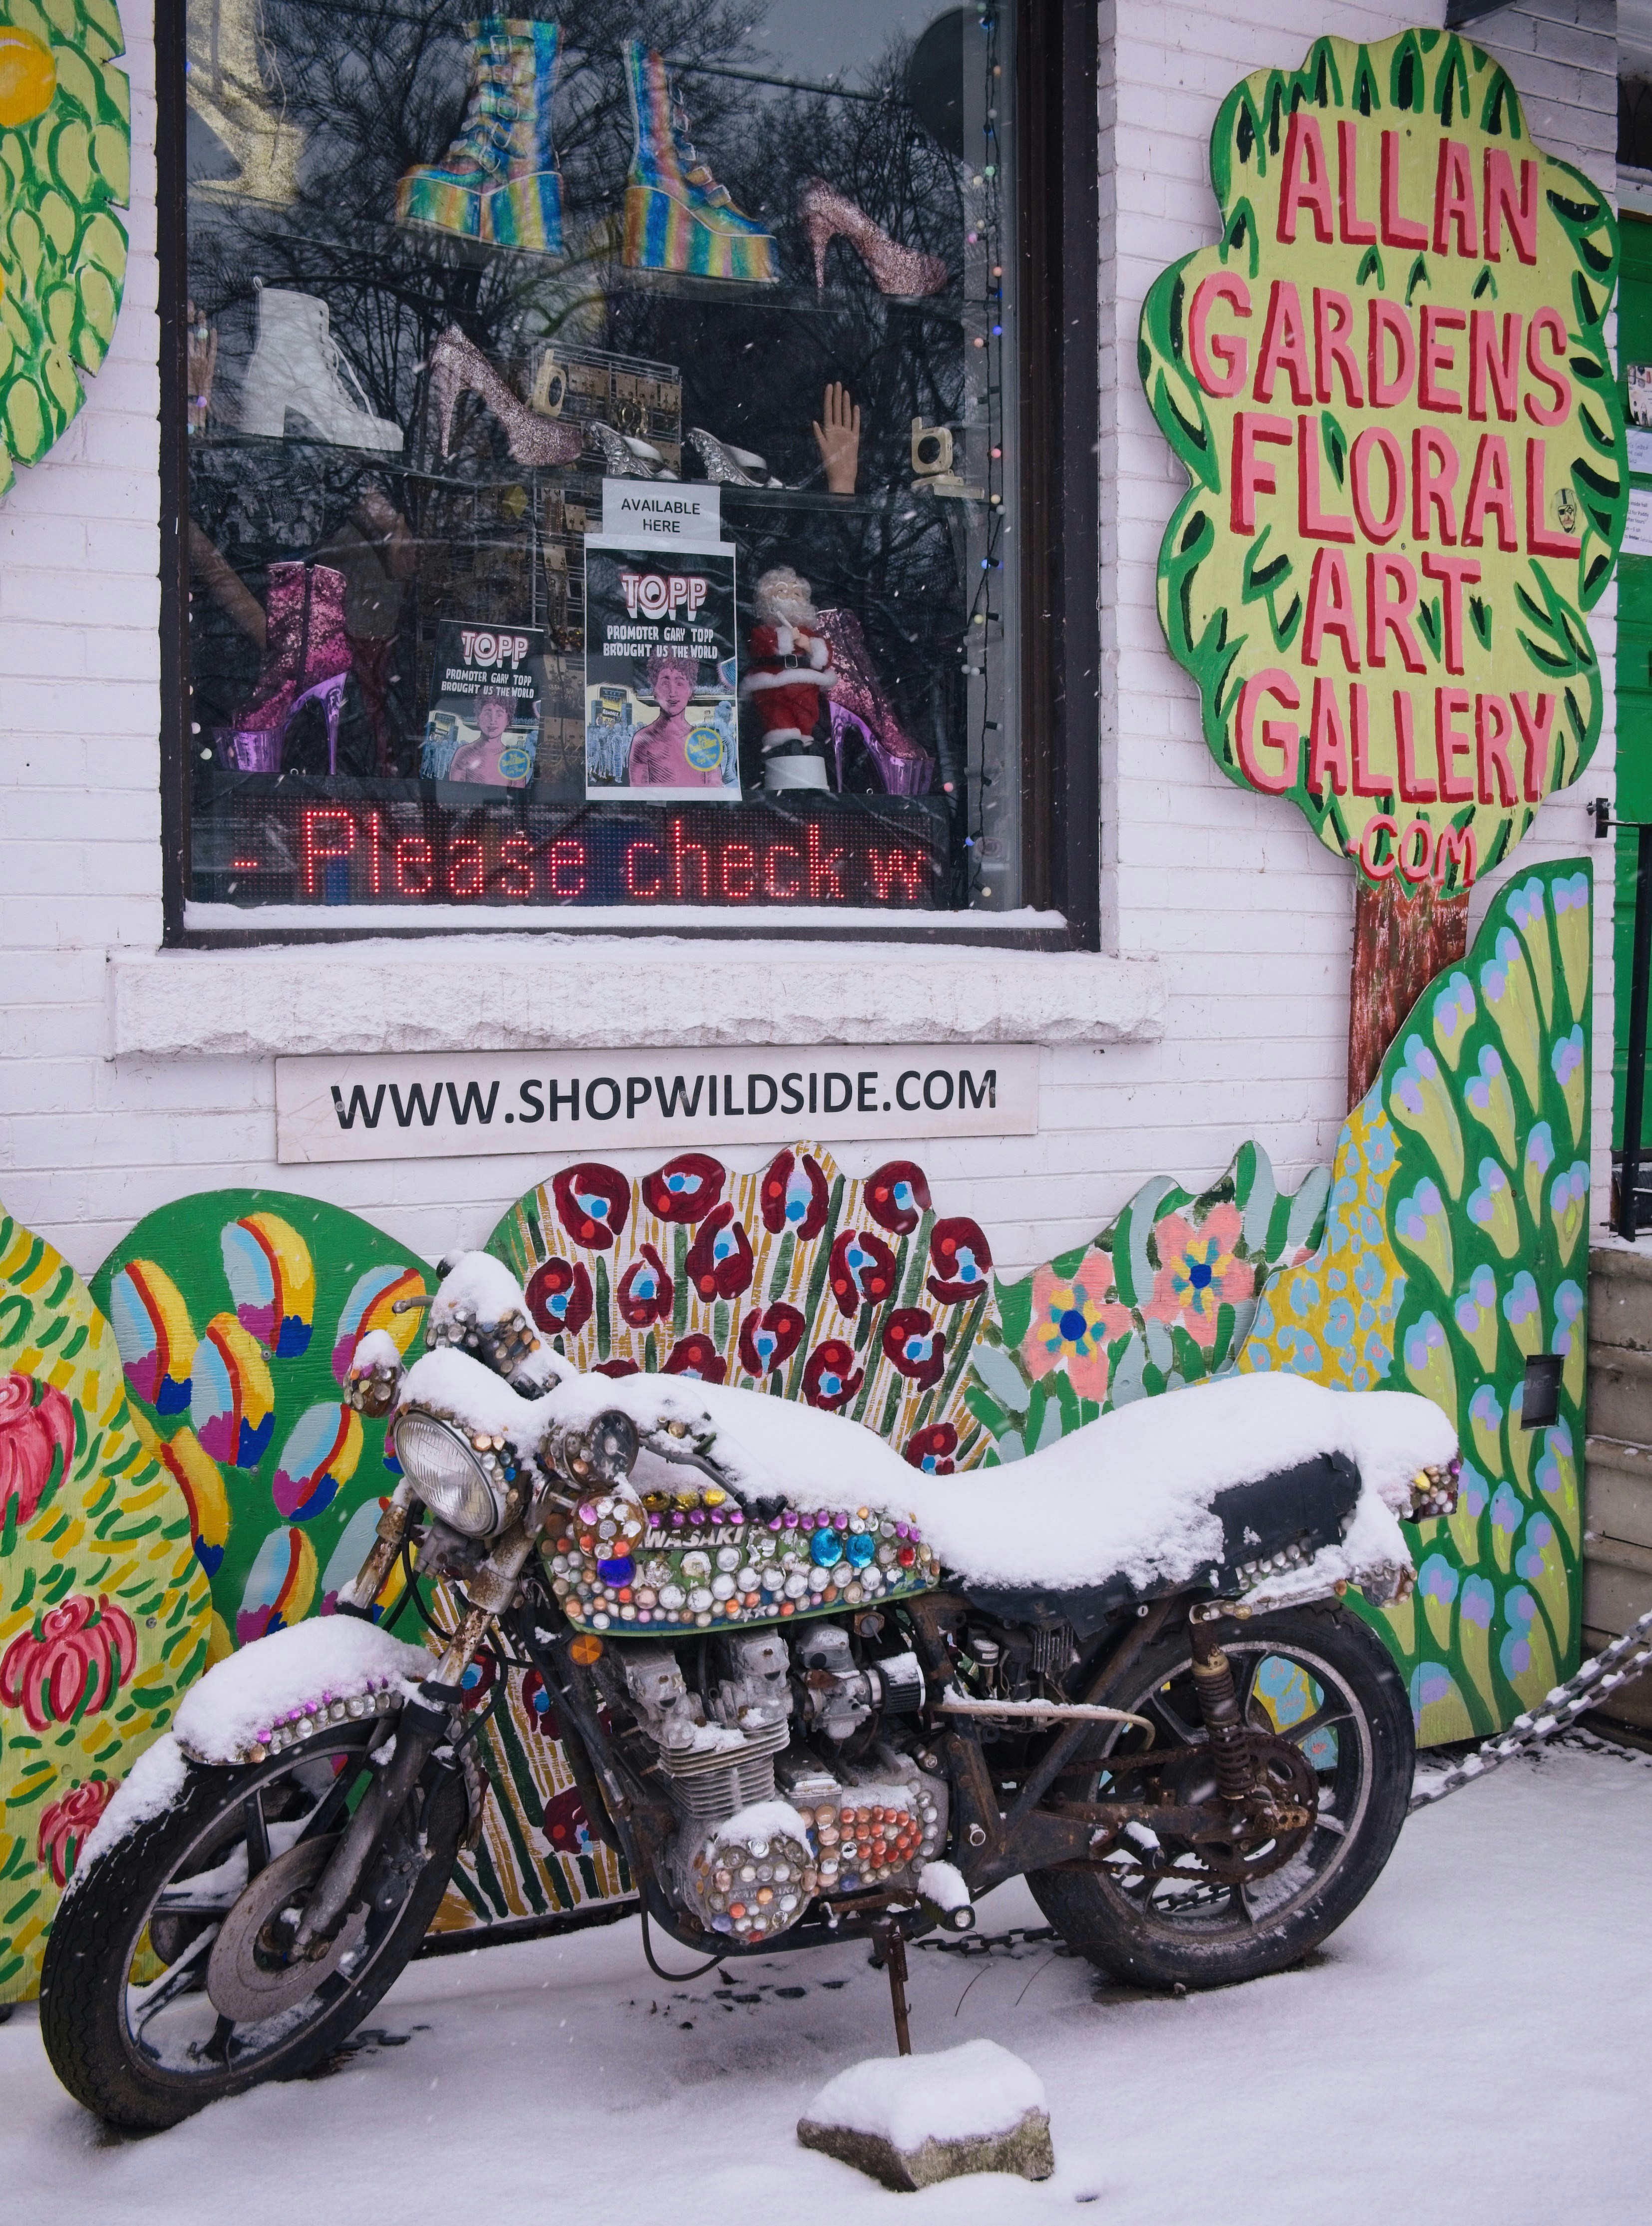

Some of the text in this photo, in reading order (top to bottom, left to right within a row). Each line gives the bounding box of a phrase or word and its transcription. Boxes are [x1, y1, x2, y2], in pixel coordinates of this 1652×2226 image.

[1277, 112, 1538, 266] ALLAN
[1189, 270, 1572, 426] GARDENS
[622, 498, 700, 515] AVAILABLE
[1230, 411, 1581, 559] FLORAL
[643, 519, 680, 533] HERE
[621, 574, 707, 621] TOPP
[1301, 547, 1481, 674] ART
[461, 631, 528, 670] TOPP
[603, 643, 718, 659] BROUGHT US THE WORLD
[607, 625, 714, 643] PROMOTER GARY TOPP
[441, 681, 534, 699] BROUGHT US THE WORLD
[446, 668, 532, 686] PROMOTER GARY TOPP
[1236, 668, 1556, 807] GALLERY
[307, 811, 584, 894] Please
[627, 820, 845, 898] check
[1345, 813, 1478, 888] .COM
[330, 1069, 997, 1130] WWW.SHOPWILDSIDE.COM
[638, 1524, 745, 1548] WASAKI
